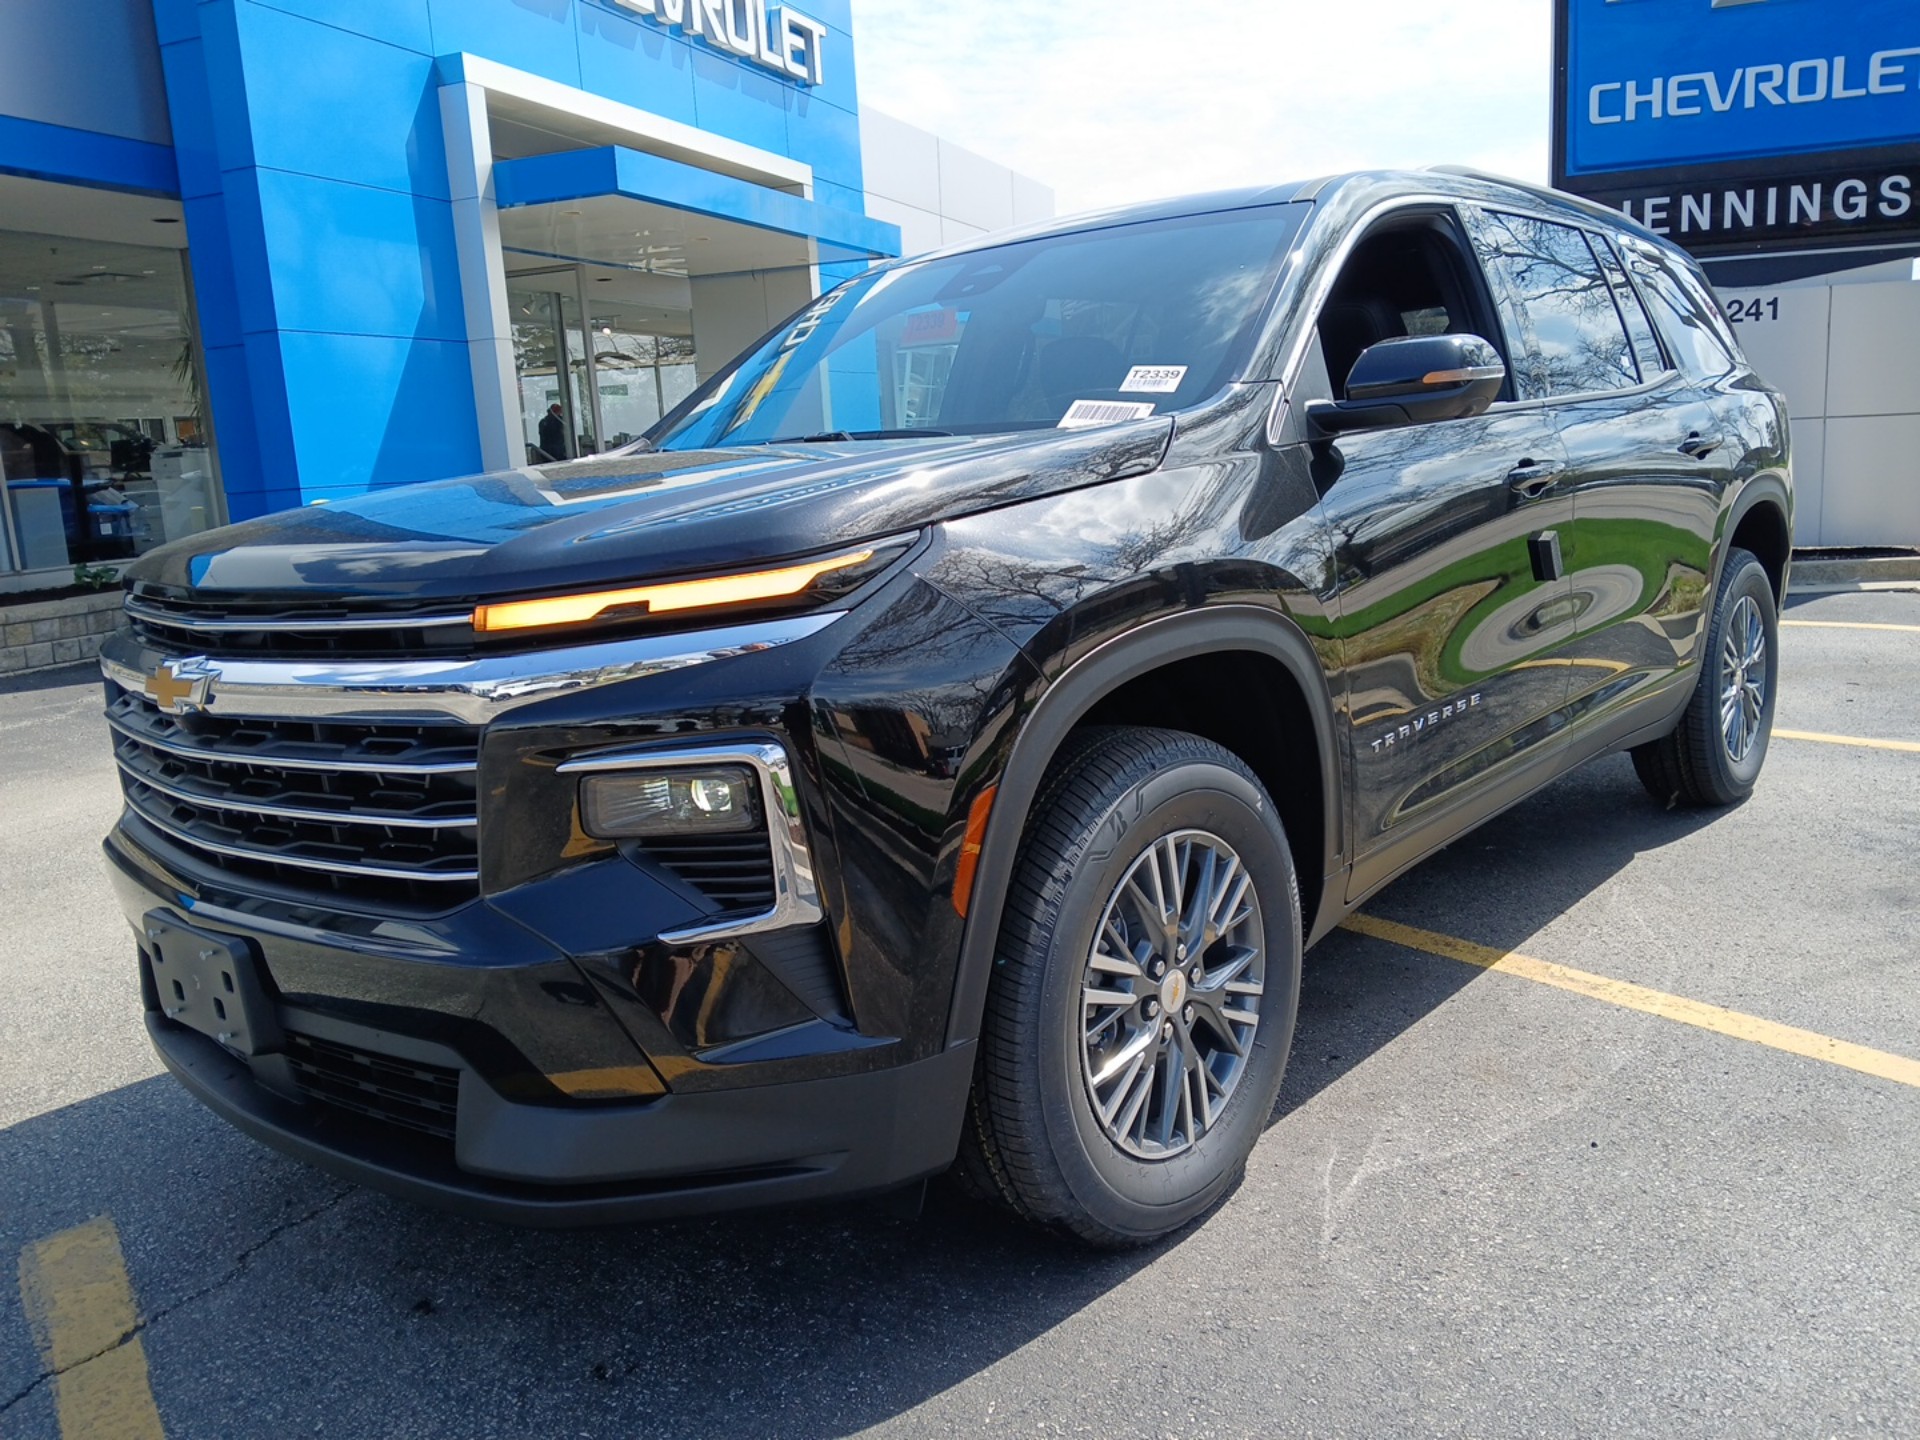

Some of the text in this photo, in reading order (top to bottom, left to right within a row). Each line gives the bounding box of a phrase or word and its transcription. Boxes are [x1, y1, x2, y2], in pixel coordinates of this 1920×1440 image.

[1589, 47, 1920, 125] CHEVROLE
[1623, 175, 1912, 235] ENNINGS
[1726, 296, 1778, 323] 241
[1133, 369, 1181, 379] T2339
[1371, 692, 1481, 753] TRAVERSE
